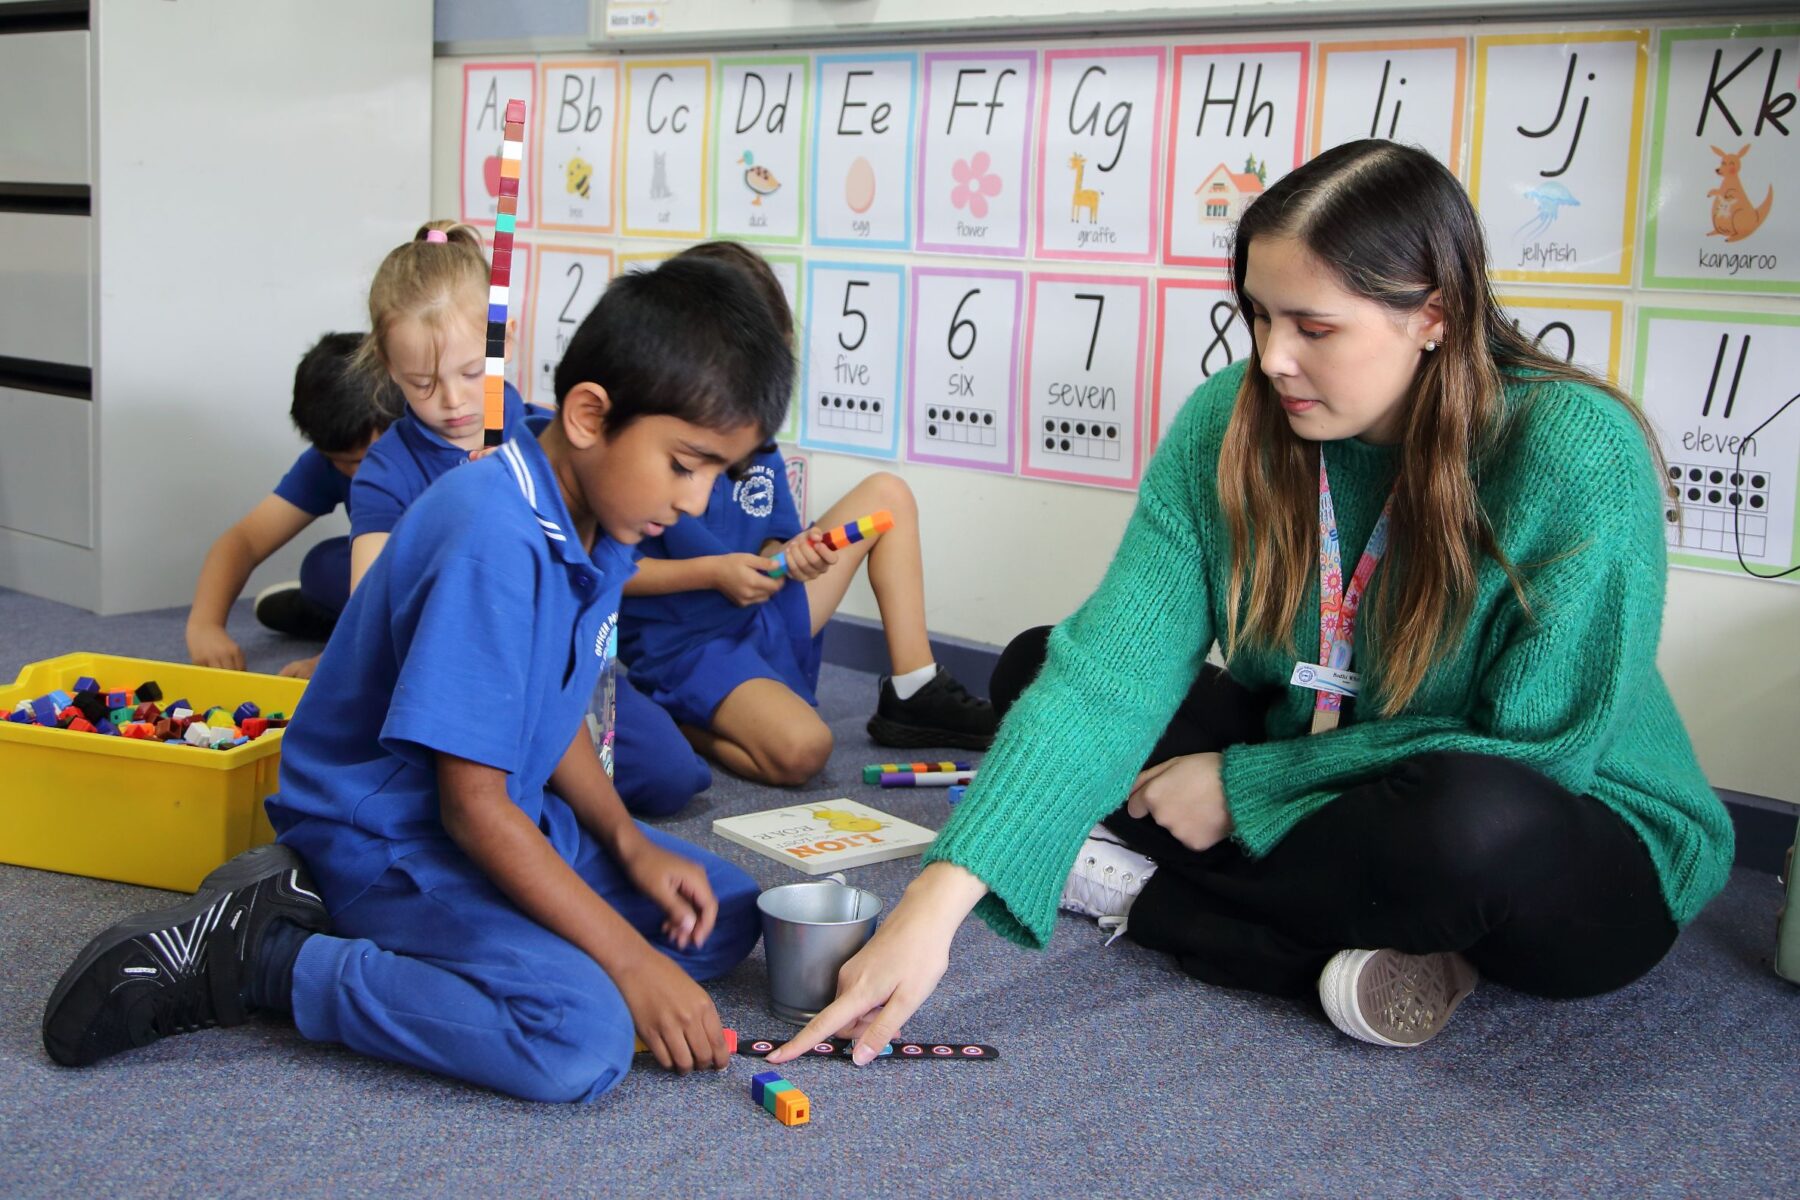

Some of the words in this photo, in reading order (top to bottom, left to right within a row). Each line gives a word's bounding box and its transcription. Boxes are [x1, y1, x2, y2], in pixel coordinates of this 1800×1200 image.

[557, 74, 602, 133] Bb
[647, 72, 690, 134] Cc
[735, 71, 793, 134] Dd
[837, 70, 891, 135] Ee
[946, 68, 1017, 135] Ff
[1069, 65, 1133, 173] Gg
[1196, 62, 1274, 137] Hh
[1370, 59, 1407, 138] Ii
[1516, 52, 1596, 178] Jj
[1695, 46, 1797, 137] Kk
[852, 220, 870, 237] egg
[957, 221, 988, 238] flower
[1077, 226, 1117, 247] giraffe
[1517, 242, 1577, 267] jellyfish
[1698, 248, 1777, 275] kangaroo
[558, 263, 583, 323] 2
[838, 280, 870, 351] 5
[948, 288, 980, 360] 6
[1074, 293, 1105, 371] 7
[1201, 300, 1238, 378] 8
[834, 355, 870, 386] five
[948, 366, 974, 397] six
[1048, 382, 1116, 412] seven
[1702, 333, 1751, 419] 11
[1682, 425, 1757, 457] eleven
[786, 832, 884, 858] LION
